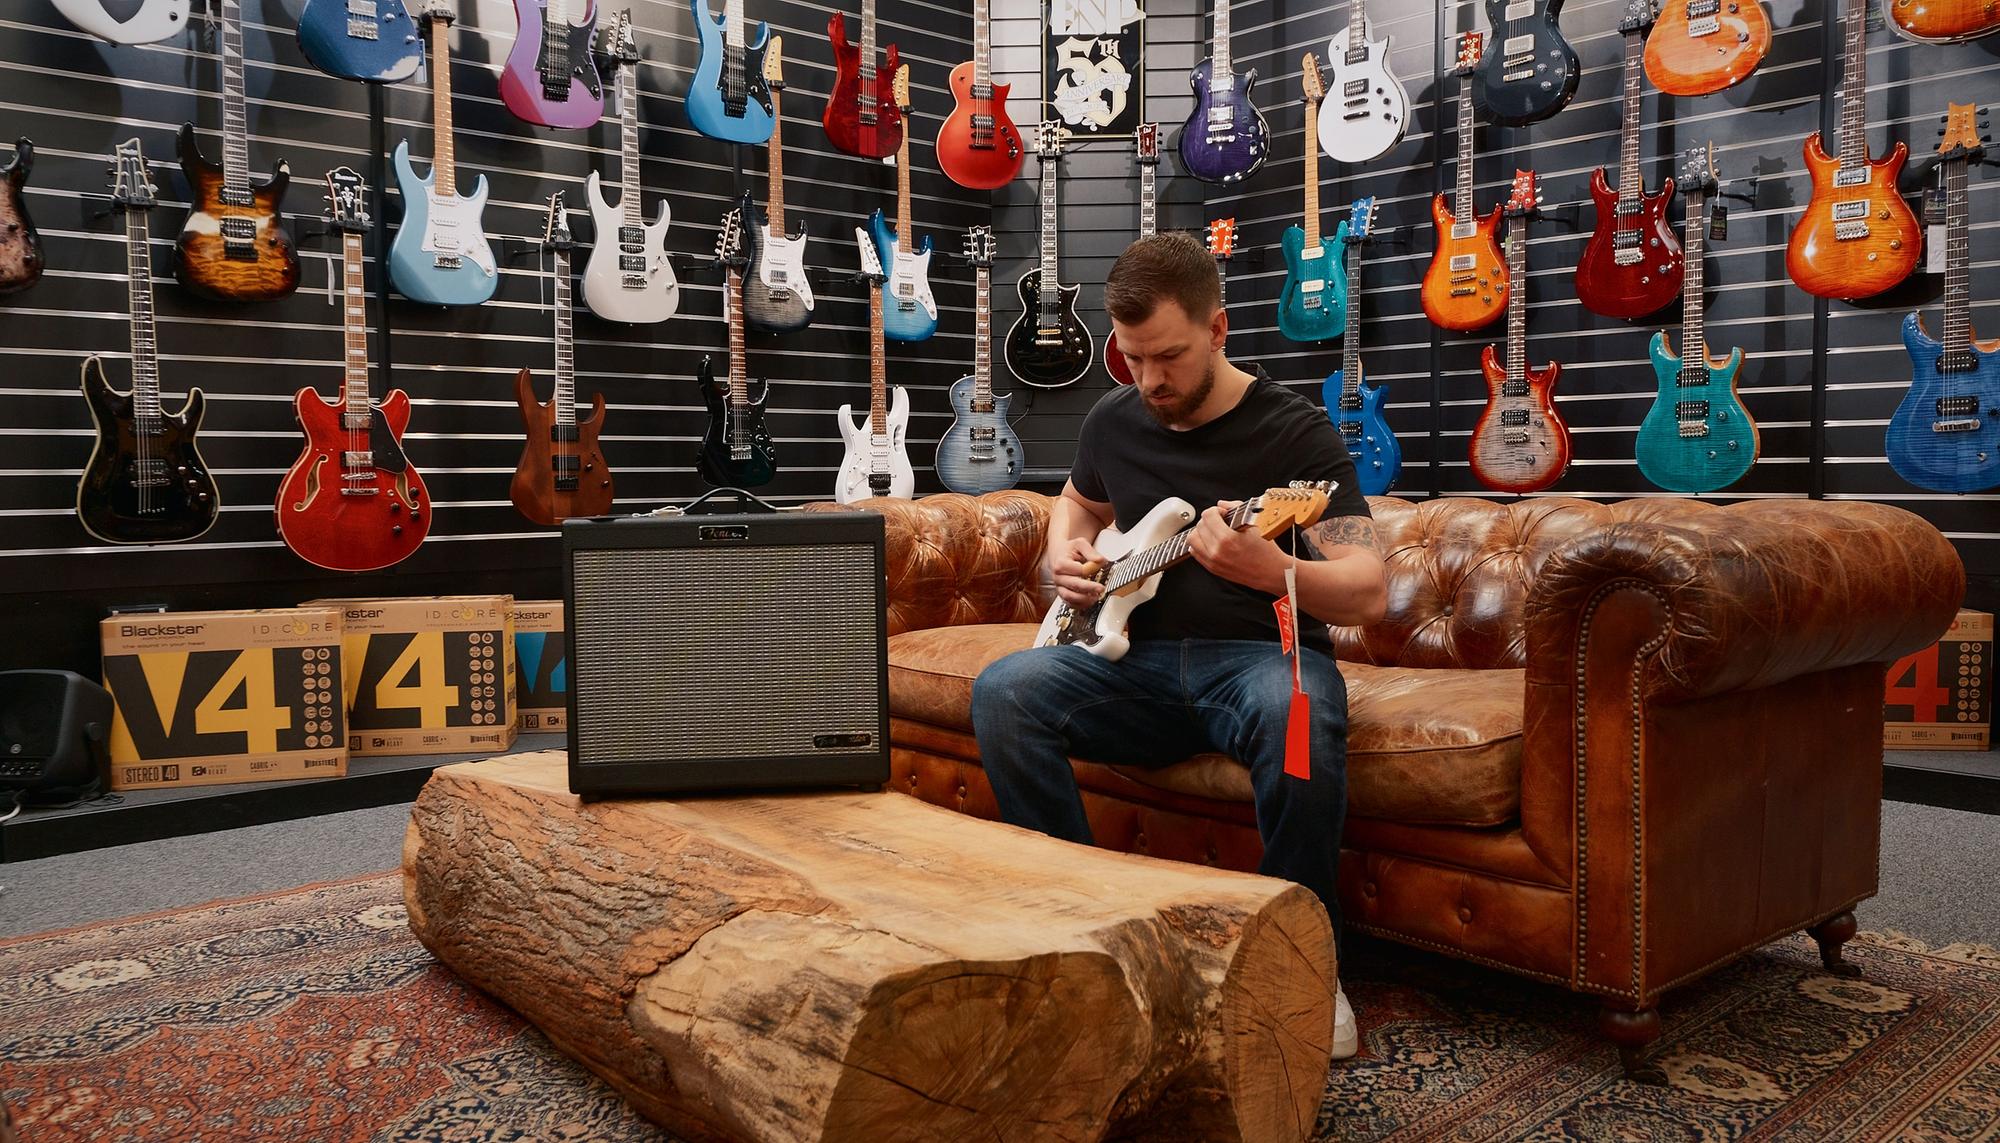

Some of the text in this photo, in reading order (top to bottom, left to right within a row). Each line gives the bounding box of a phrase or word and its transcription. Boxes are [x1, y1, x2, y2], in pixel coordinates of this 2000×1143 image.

[121, 623, 204, 637] Blackstar
[104, 648, 291, 760] V4
[126, 766, 177, 783] STEREO 40
